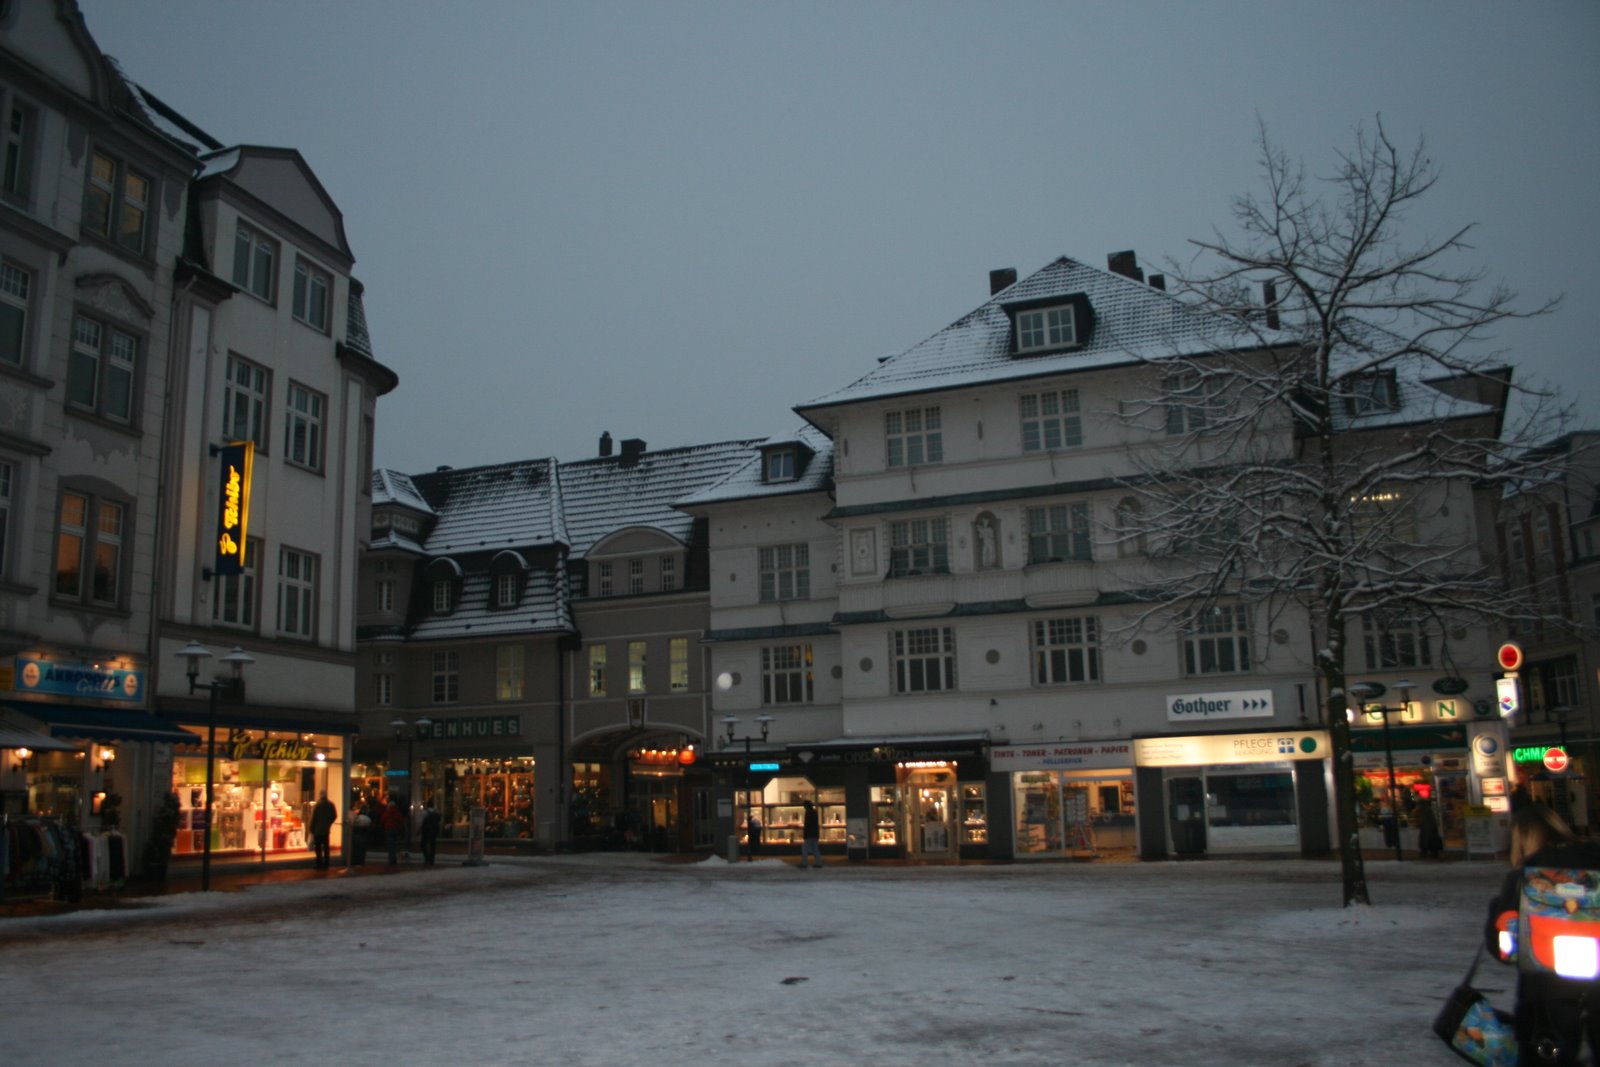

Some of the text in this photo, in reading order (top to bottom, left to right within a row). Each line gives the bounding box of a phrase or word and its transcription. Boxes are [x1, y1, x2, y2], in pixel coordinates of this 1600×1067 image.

[224, 465, 240, 529] Tchibo
[1172, 698, 1230, 715] Gothaer
[420, 719, 518, 738] ENHUES
[261, 738, 313, 760] Tchibo
[1022, 749, 1047, 757] TONER
[1101, 745, 1129, 754] PAPIER
[1233, 738, 1273, 749] PFLEGE
